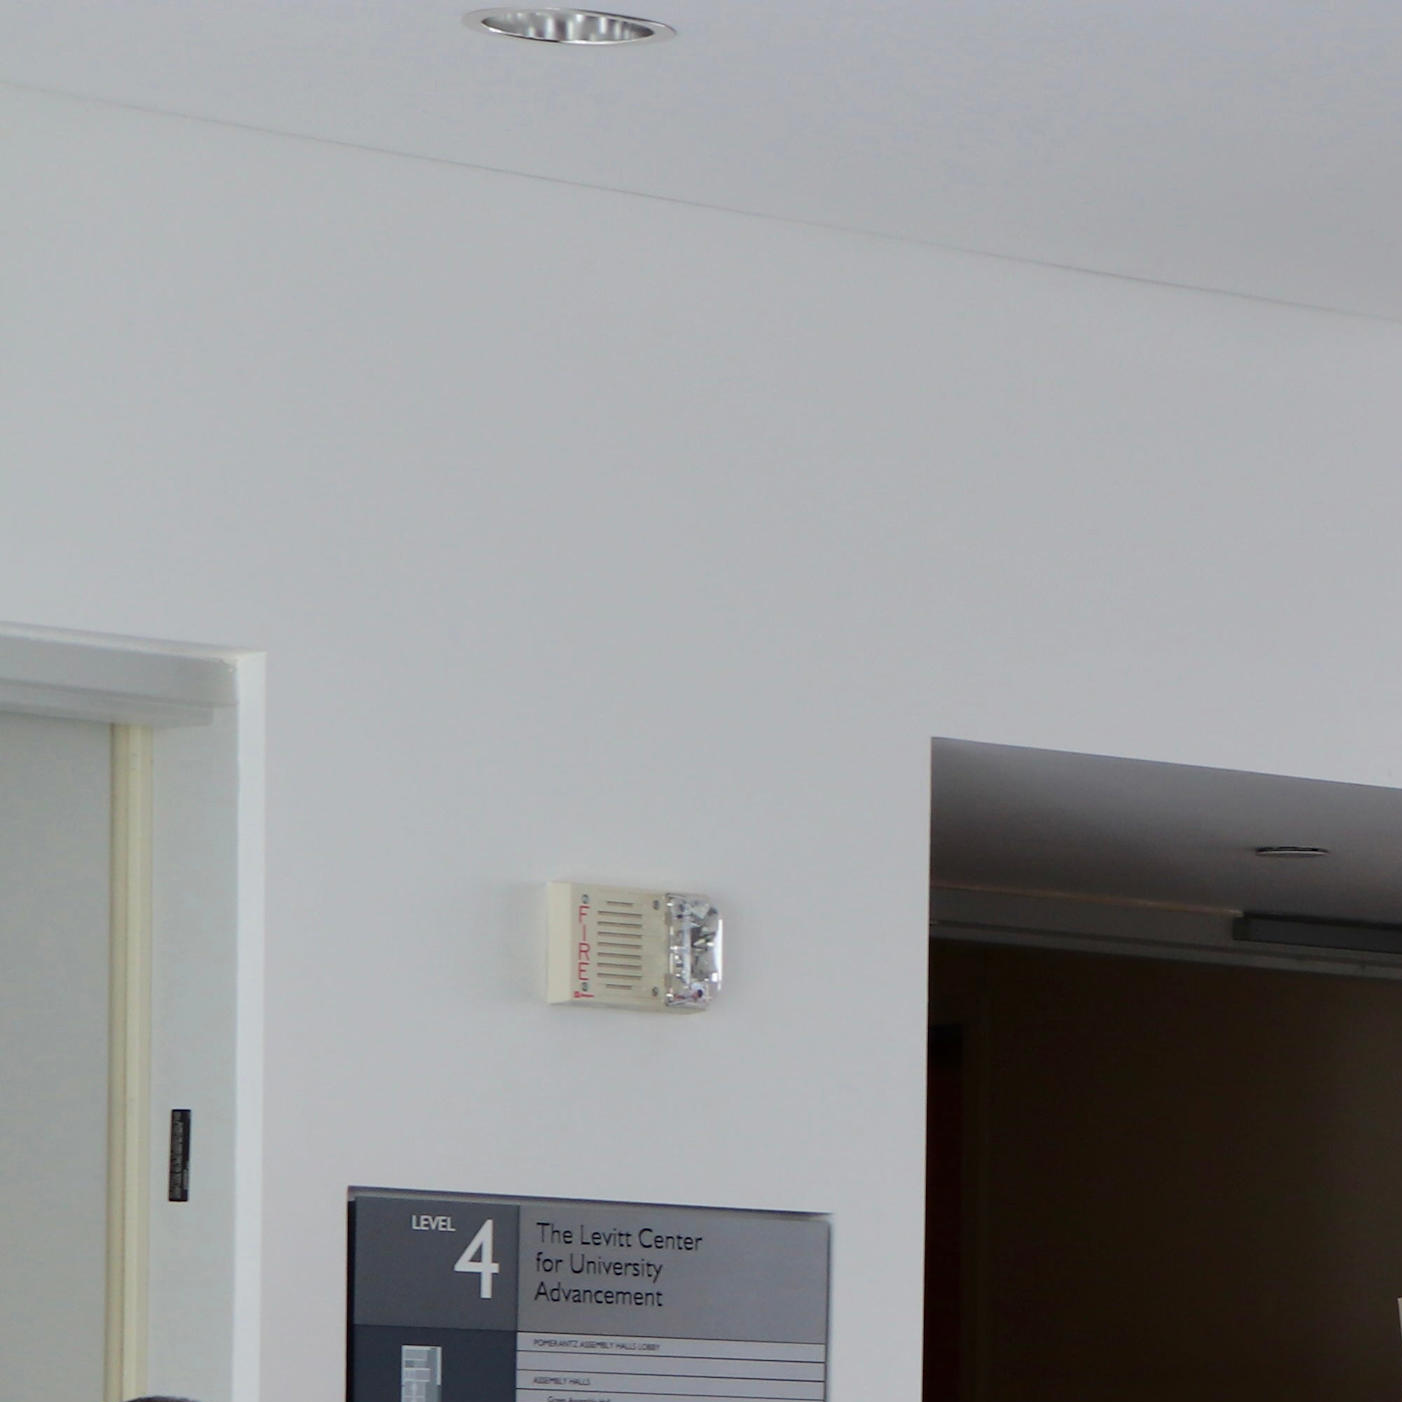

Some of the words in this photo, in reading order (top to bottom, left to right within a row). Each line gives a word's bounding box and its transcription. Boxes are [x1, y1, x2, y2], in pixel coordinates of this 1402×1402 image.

[578, 905, 591, 981] FIRE
[412, 1215, 455, 1231] LEVEL
[536, 1222, 573, 1245] The
[580, 1224, 632, 1248] Levitt
[638, 1228, 703, 1251] Center
[454, 1219, 499, 1299] 4
[535, 1252, 563, 1273] for
[570, 1254, 663, 1283] University
[534, 1281, 663, 1307] Advancement
